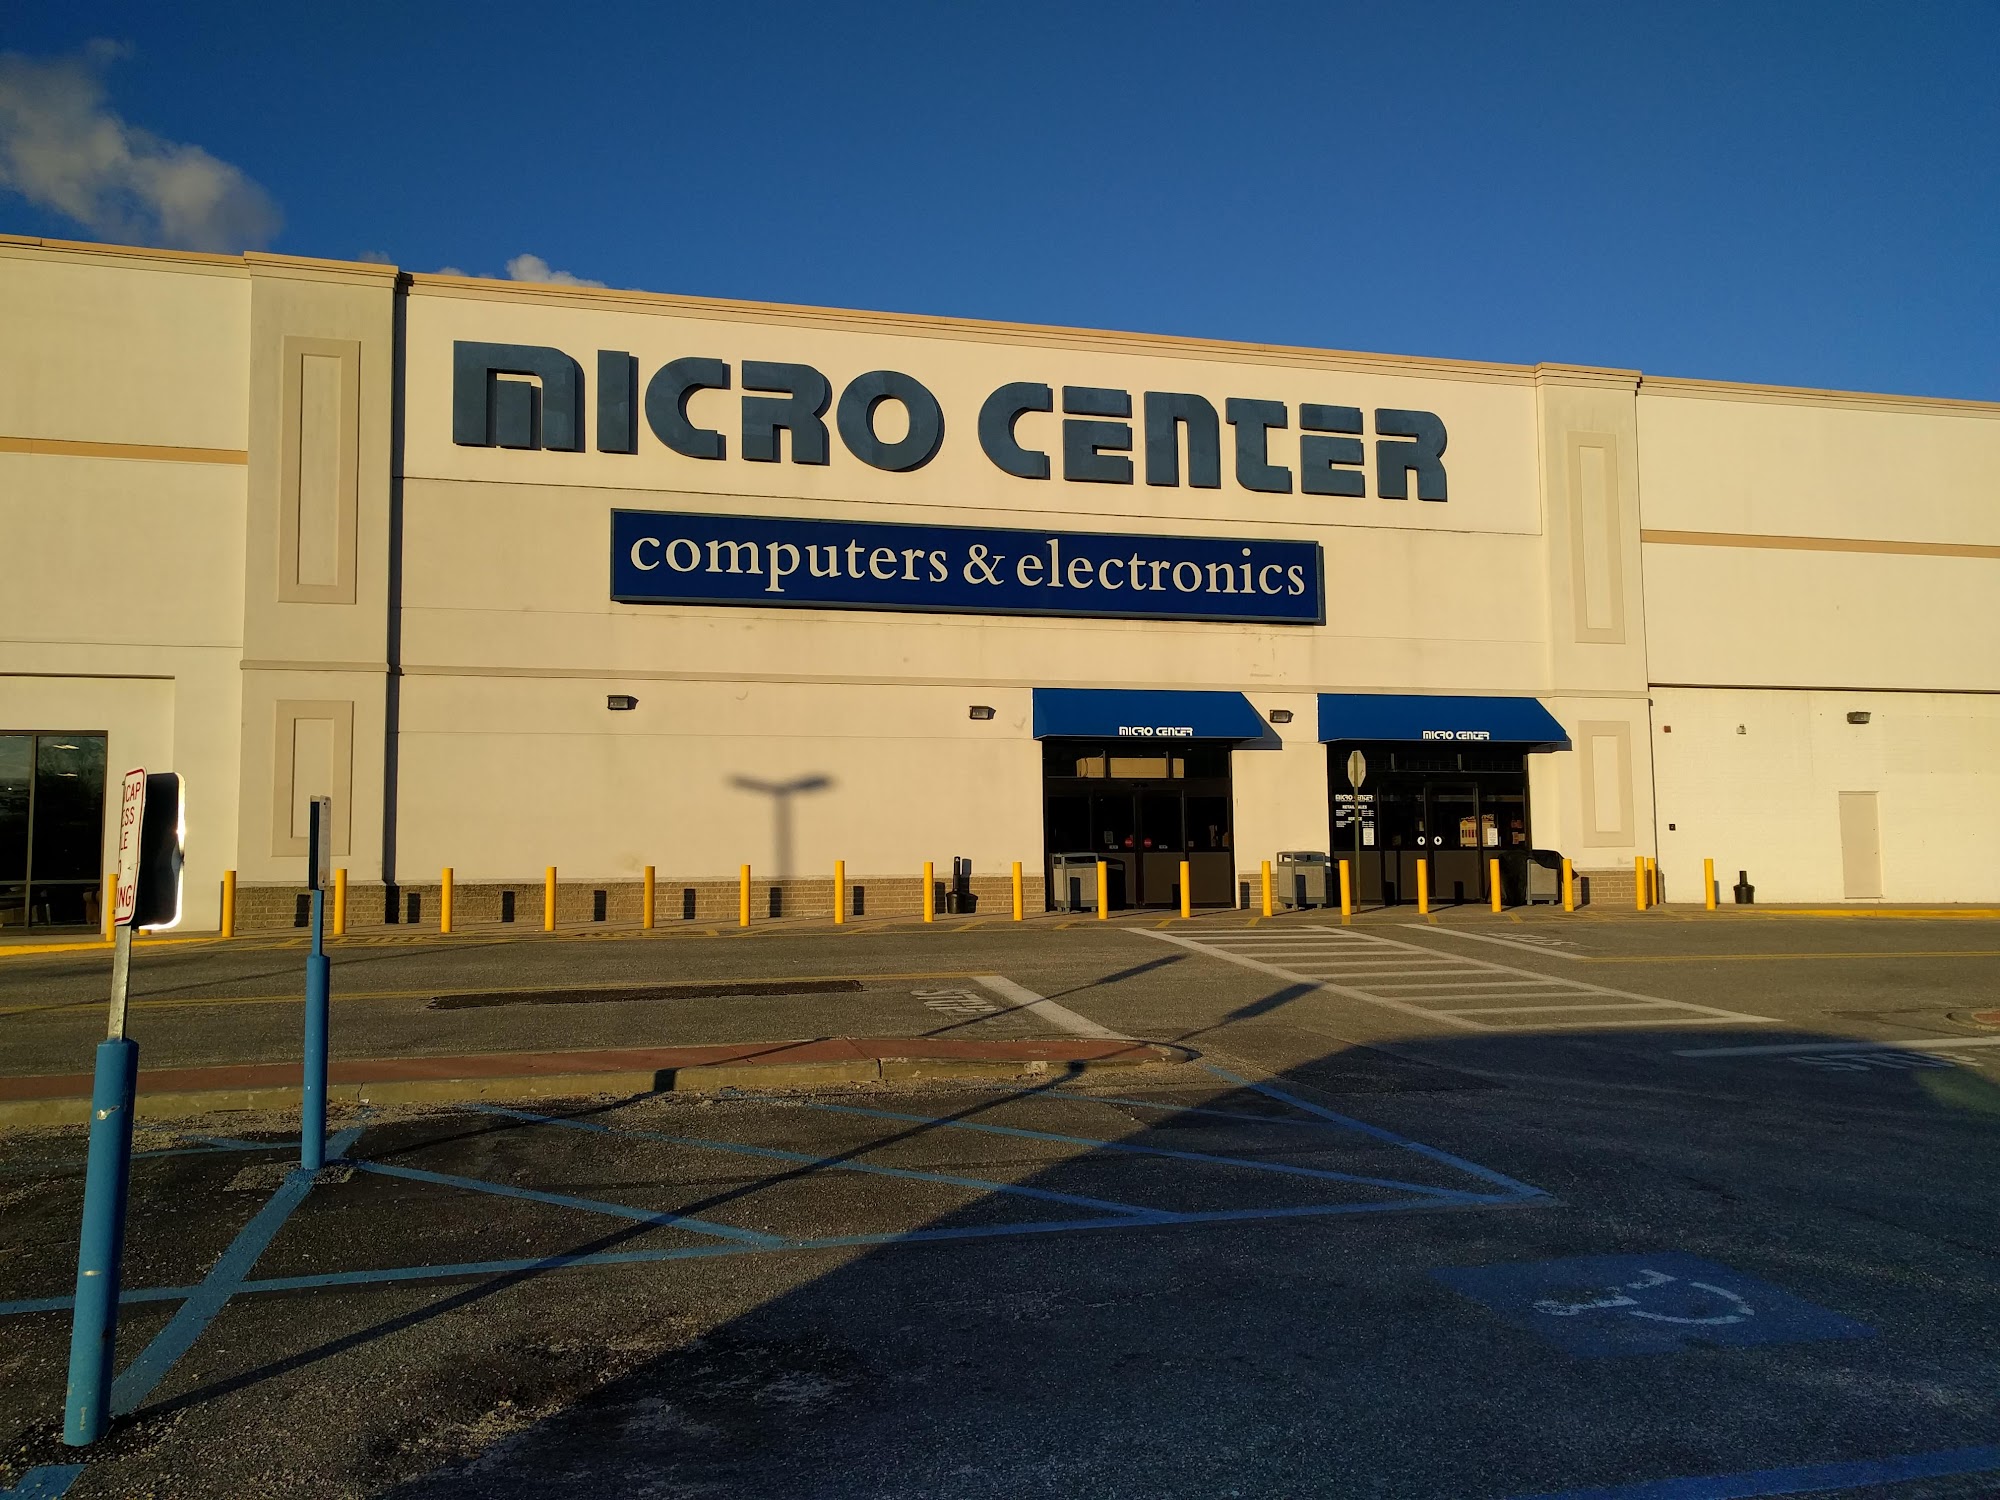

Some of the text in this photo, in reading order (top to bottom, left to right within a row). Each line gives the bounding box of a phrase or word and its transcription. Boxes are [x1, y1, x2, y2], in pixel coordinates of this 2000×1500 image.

[453, 340, 1447, 502] MICRO CENTER
[630, 535, 1305, 595] computers & electronics
[1119, 726, 1193, 737] MICRO CENTER
[1422, 730, 1490, 741] MICRO CENTER
